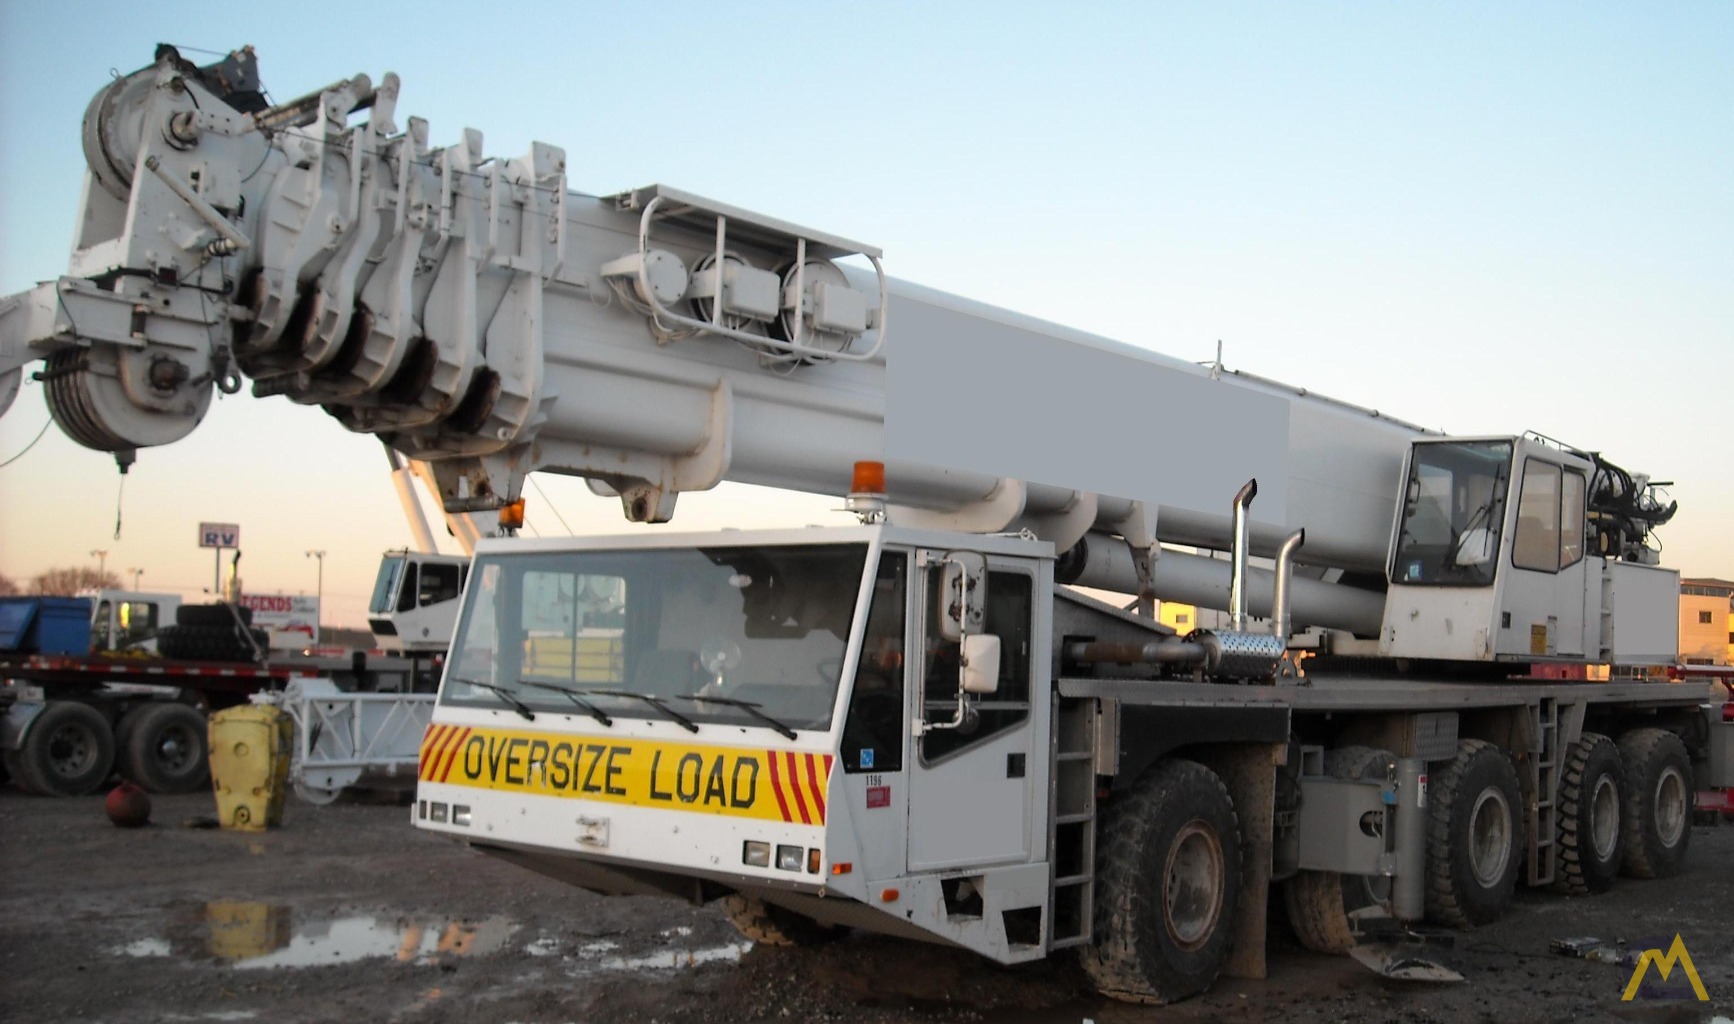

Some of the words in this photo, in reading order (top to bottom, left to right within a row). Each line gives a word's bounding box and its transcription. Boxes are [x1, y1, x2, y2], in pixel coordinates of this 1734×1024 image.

[205, 532, 234, 545] RV
[464, 735, 632, 796] OVERSIZE
[650, 750, 759, 809] LOAD
[866, 774, 882, 786] 1196
